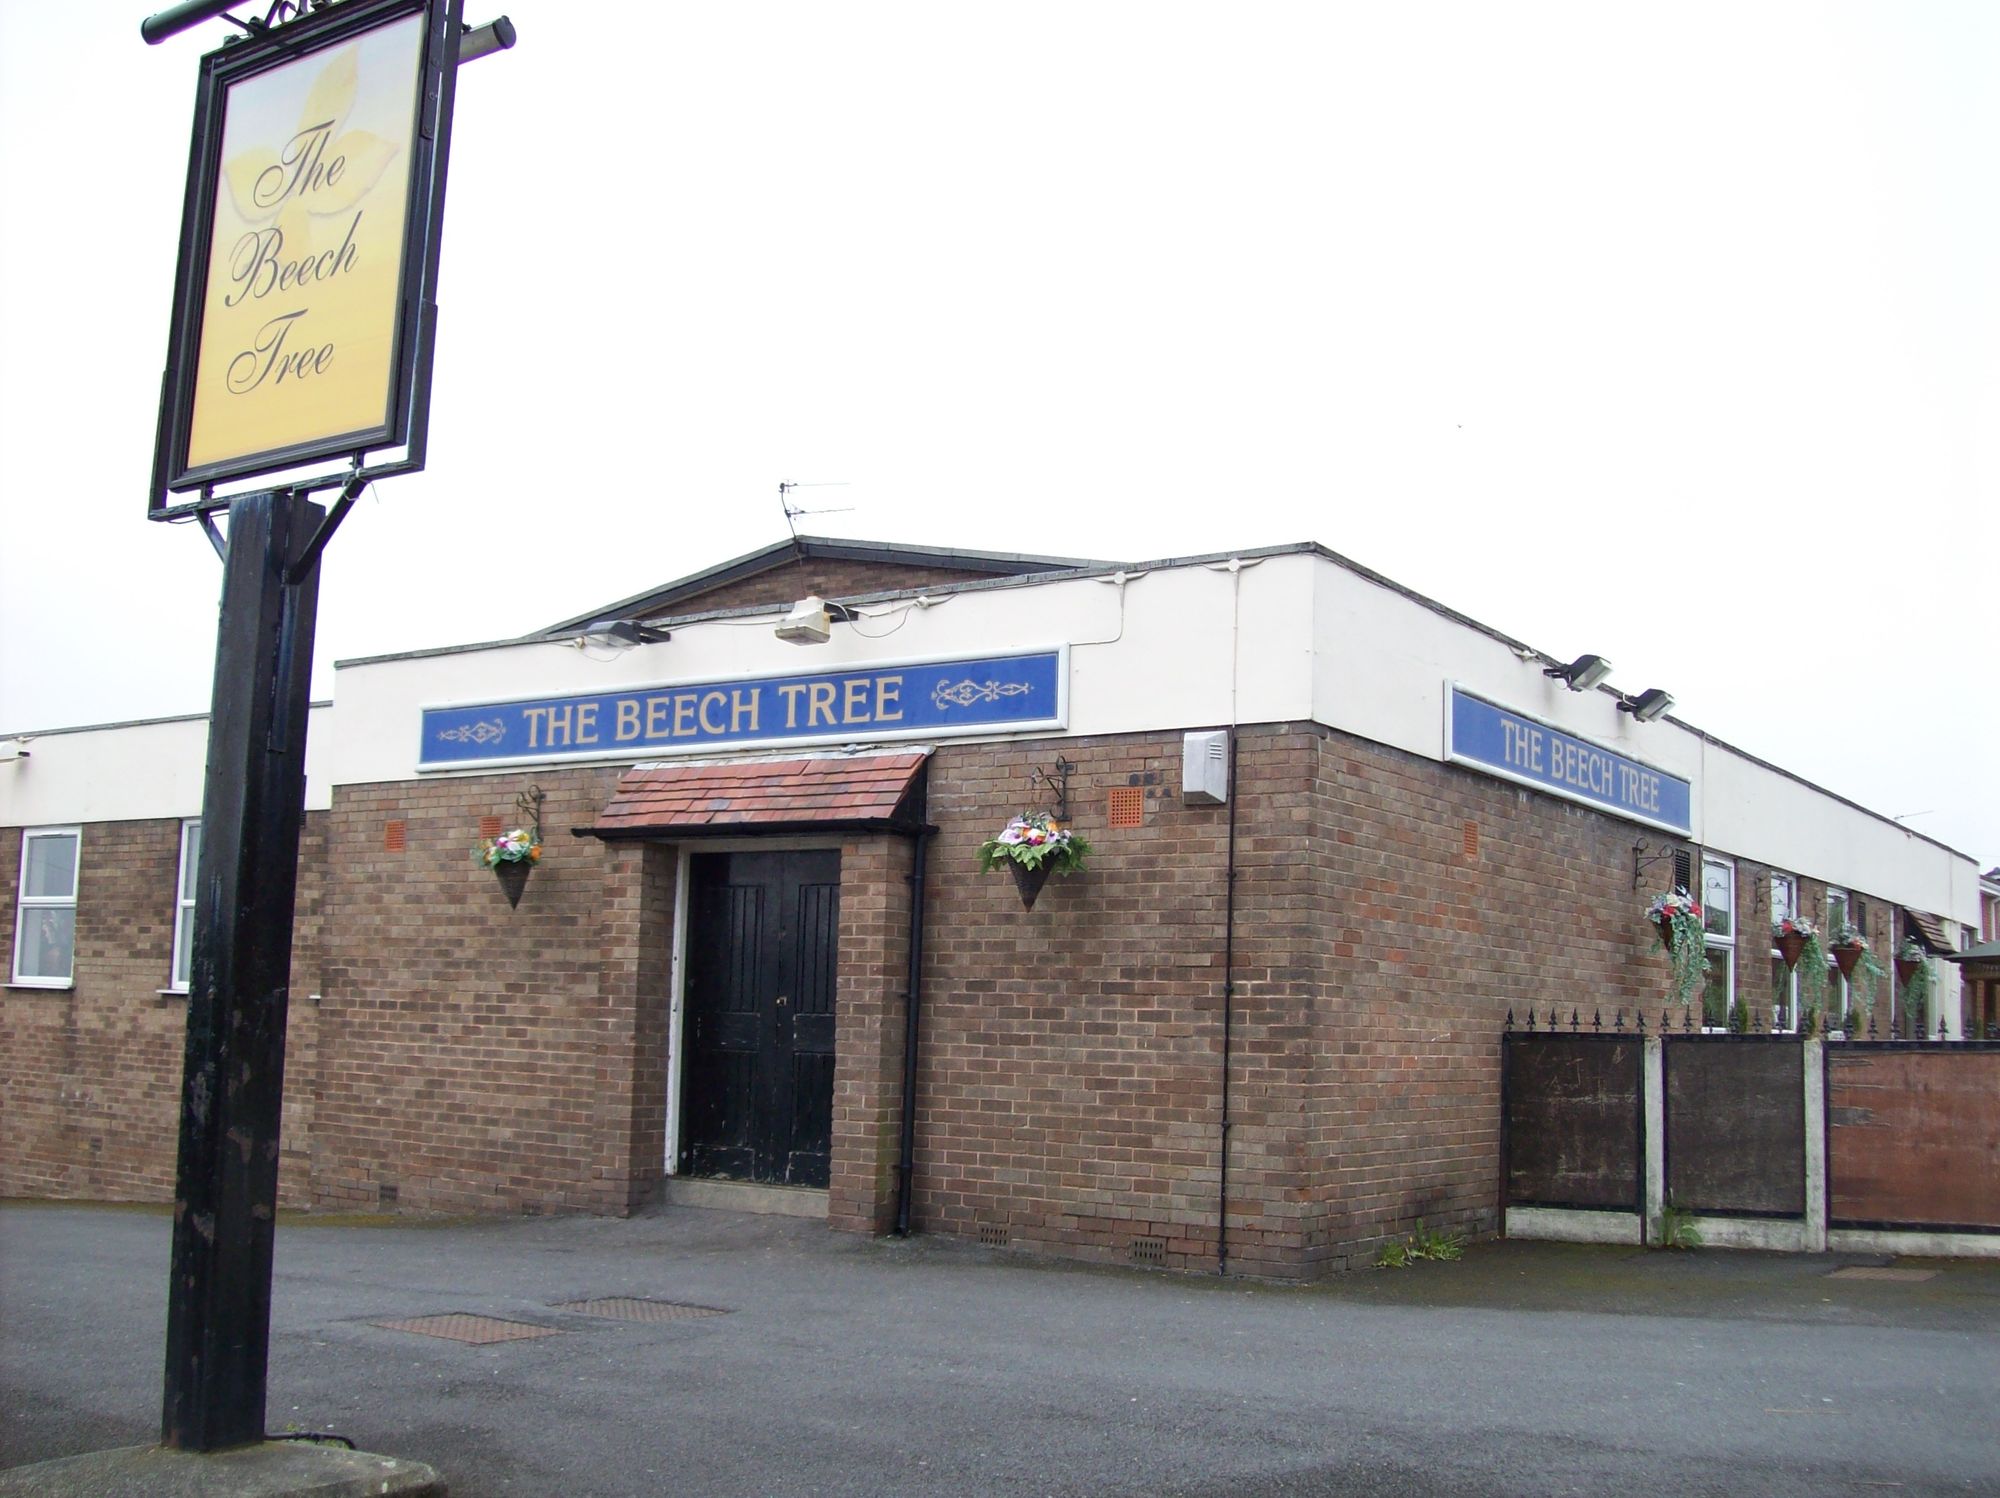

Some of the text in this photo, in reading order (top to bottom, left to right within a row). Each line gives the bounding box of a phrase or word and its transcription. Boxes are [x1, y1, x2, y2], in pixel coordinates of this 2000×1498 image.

[253, 119, 346, 208] The
[224, 210, 364, 307] Beech
[226, 309, 335, 395] Tree
[524, 677, 903, 747] THE BEECH TREE
[1501, 719, 1660, 812] THE BEECH TREE
